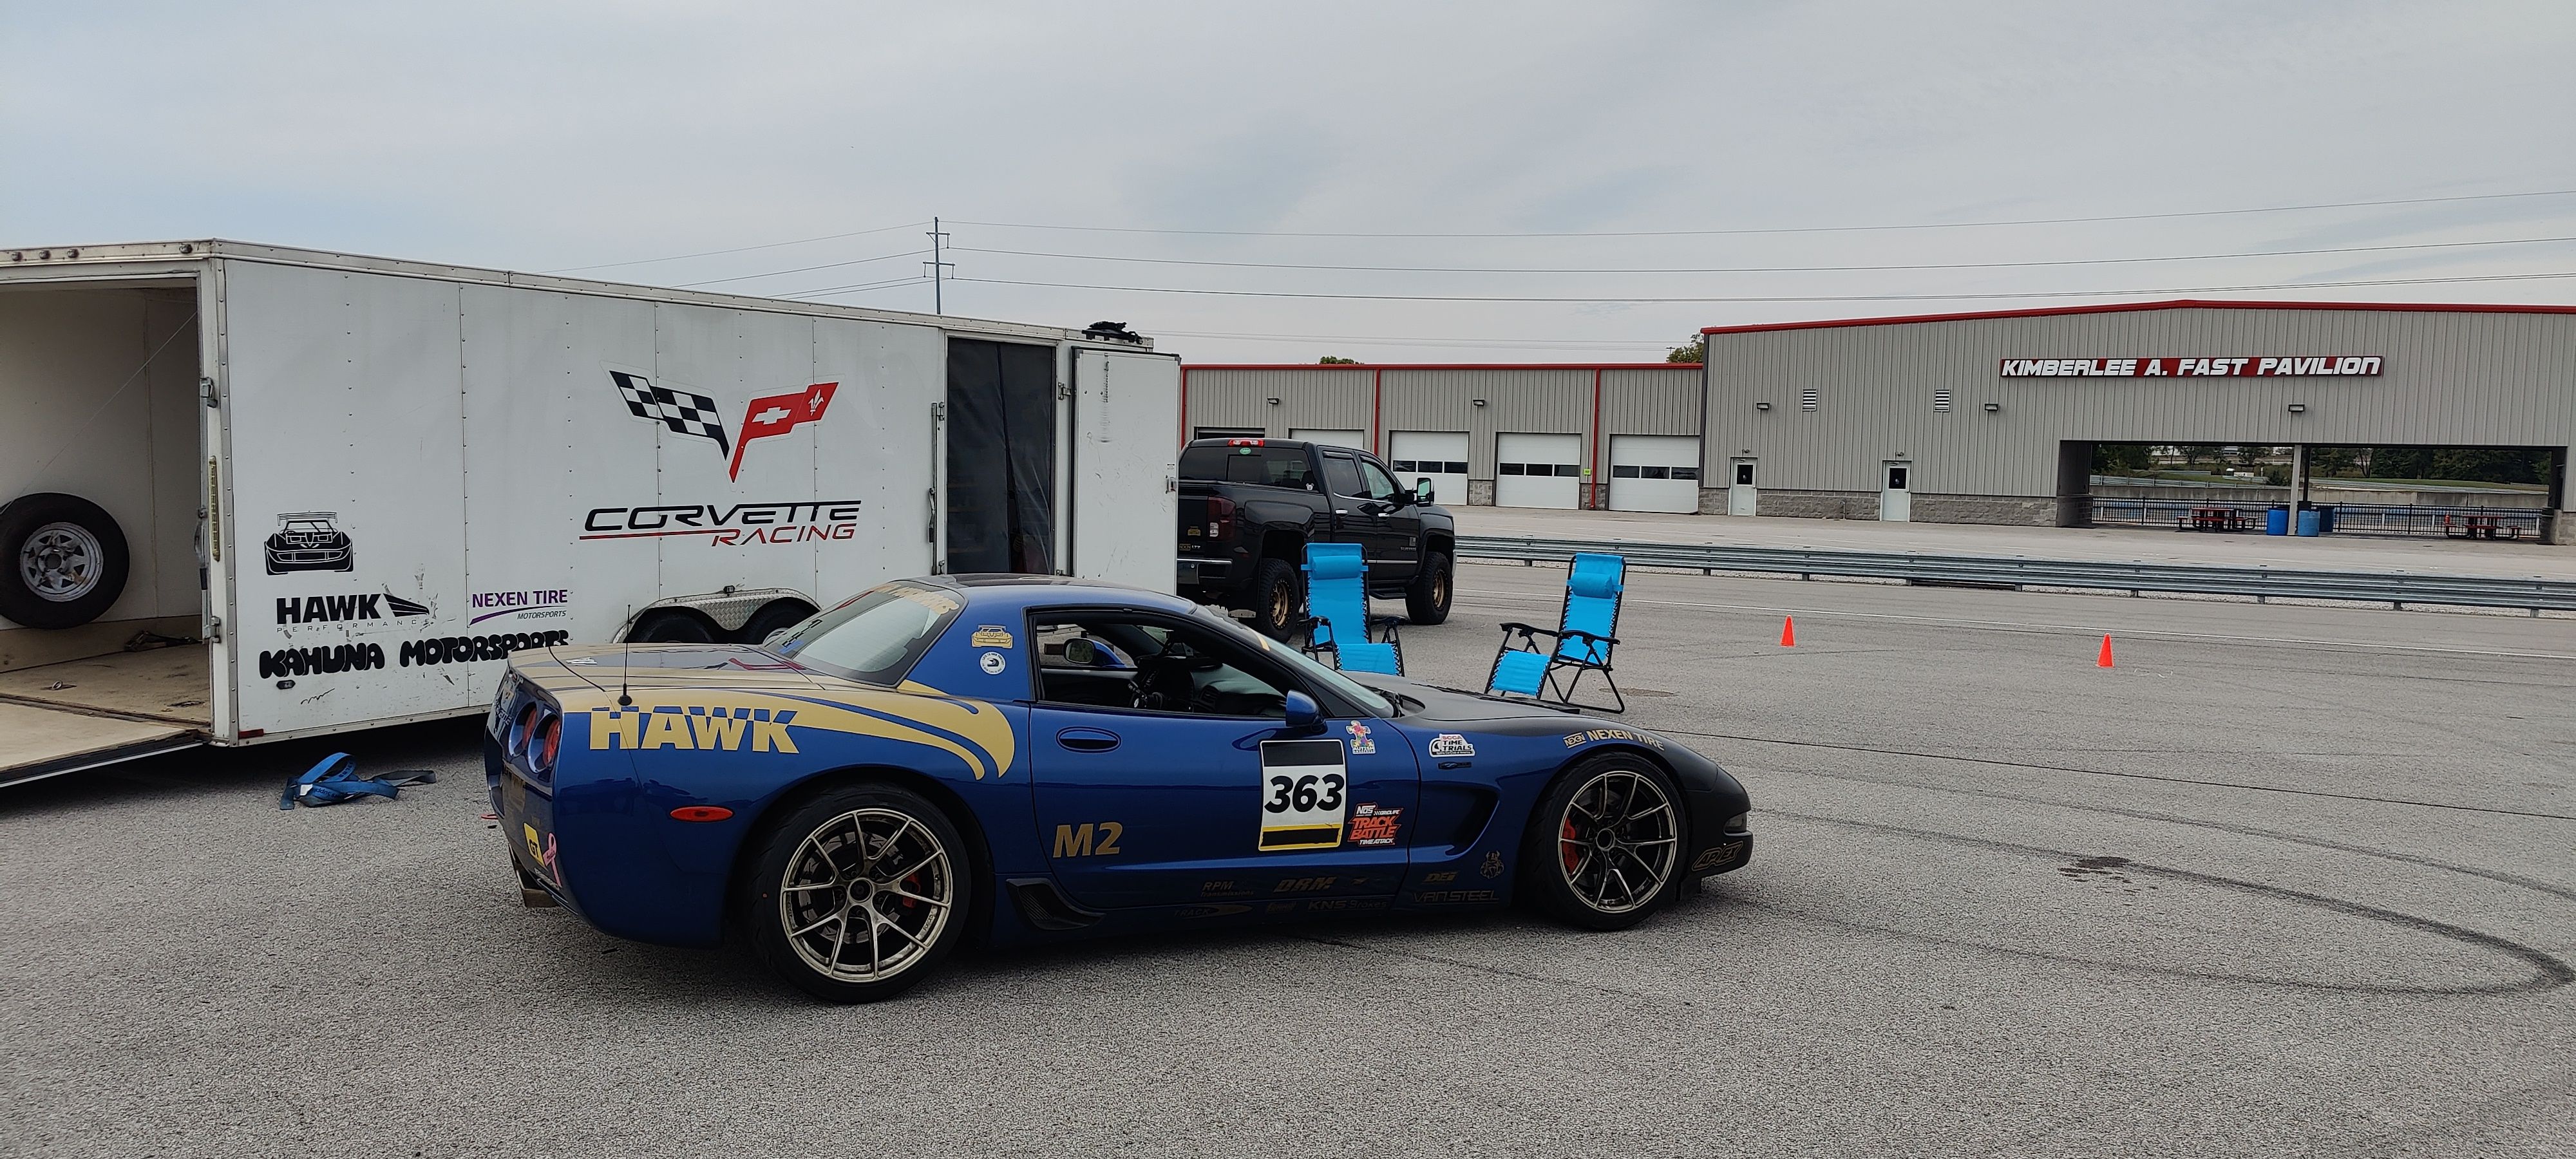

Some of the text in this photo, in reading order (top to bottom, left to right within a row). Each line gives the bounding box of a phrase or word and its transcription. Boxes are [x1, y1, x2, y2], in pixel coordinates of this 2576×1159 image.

[2002, 357, 2381, 376] KIMBERLEE A. FAST PAVILION
[584, 500, 862, 532] CORVETTE
[712, 523, 857, 547] RACING
[471, 589, 568, 608] NEXEN TIRE
[276, 593, 382, 625] HAWK
[516, 610, 567, 620] MOTORSPORTS
[276, 618, 430, 633] PERFORMANCE
[259, 630, 569, 679] KAHUNA MOTORSPORTS
[590, 706, 800, 754] HAWK
[1586, 729, 1665, 751] NEXEN TIRE
[1264, 775, 1345, 813] 363
[1356, 805, 1376, 815] NOS
[1352, 816, 1397, 829] TRACK
[1052, 822, 1123, 858] M2
[1350, 826, 1398, 840] BATTLE
[529, 839, 540, 858] GT
[1202, 881, 1235, 891] RPM
[1273, 876, 1338, 894] DRM
[1309, 900, 1348, 911] KNS
